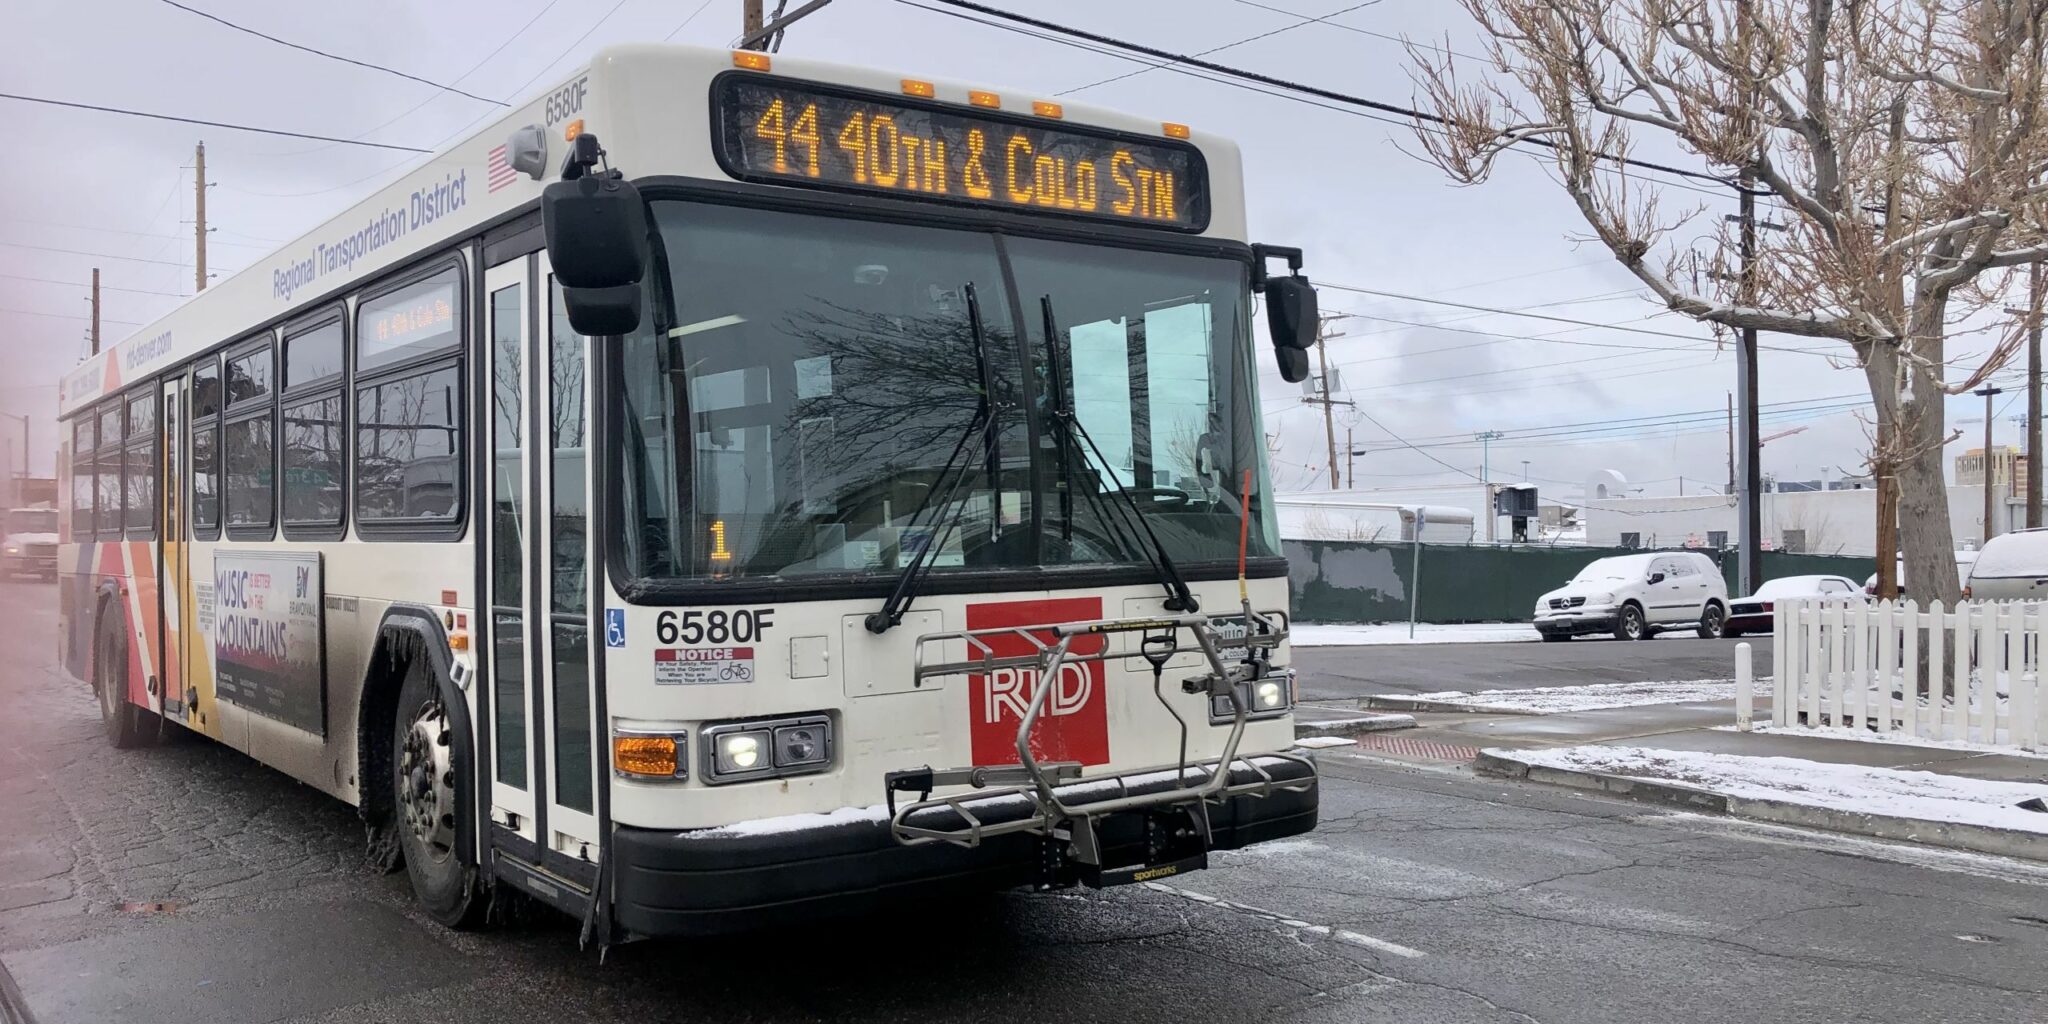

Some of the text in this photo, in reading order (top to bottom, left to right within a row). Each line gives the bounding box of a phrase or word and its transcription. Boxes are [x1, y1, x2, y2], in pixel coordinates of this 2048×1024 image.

[546, 76, 588, 128] 6580F
[757, 99, 820, 177] 44
[964, 128, 991, 198] &
[273, 168, 466, 301] Regional Transportation District
[710, 520, 731, 559] 1
[216, 570, 248, 609] MUSIC
[219, 614, 287, 661] MOUNTAINS
[656, 608, 775, 645] 6580F
[675, 648, 733, 661] NOTICE
[1133, 865, 1177, 881] sportworks
